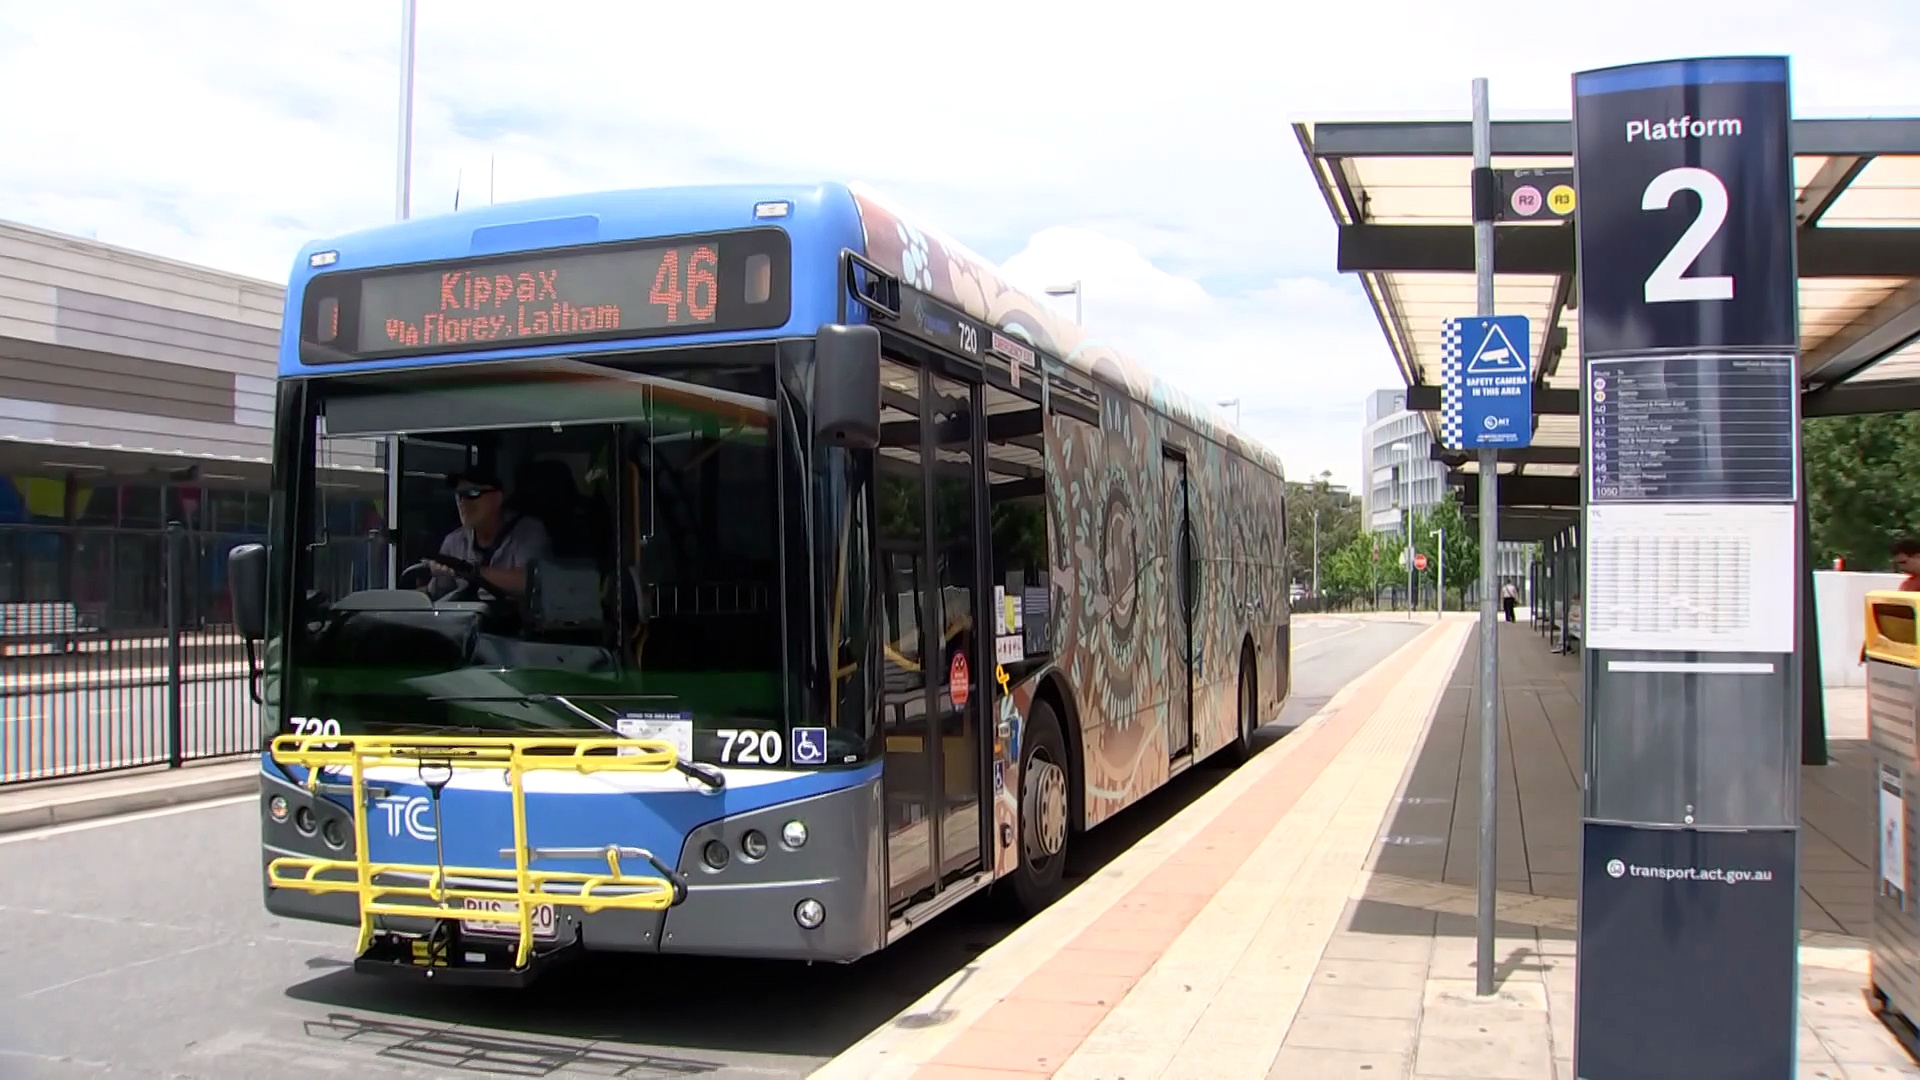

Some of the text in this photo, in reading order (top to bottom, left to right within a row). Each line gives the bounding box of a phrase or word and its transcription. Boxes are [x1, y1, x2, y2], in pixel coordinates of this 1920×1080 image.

[1626, 116, 1743, 143] Platform
[1518, 194, 1570, 206] R2 R3
[1641, 167, 1735, 304] 2
[440, 269, 558, 311] Kippax
[648, 246, 718, 322] 46
[957, 320, 978, 354] 720
[1466, 376, 1527, 387] SAFETY CAMERA
[1472, 386, 1521, 397] IN THIS AREA
[716, 729, 783, 765] 720
[375, 796, 438, 842] TC
[1628, 863, 1773, 885] transport.act.gov.au
